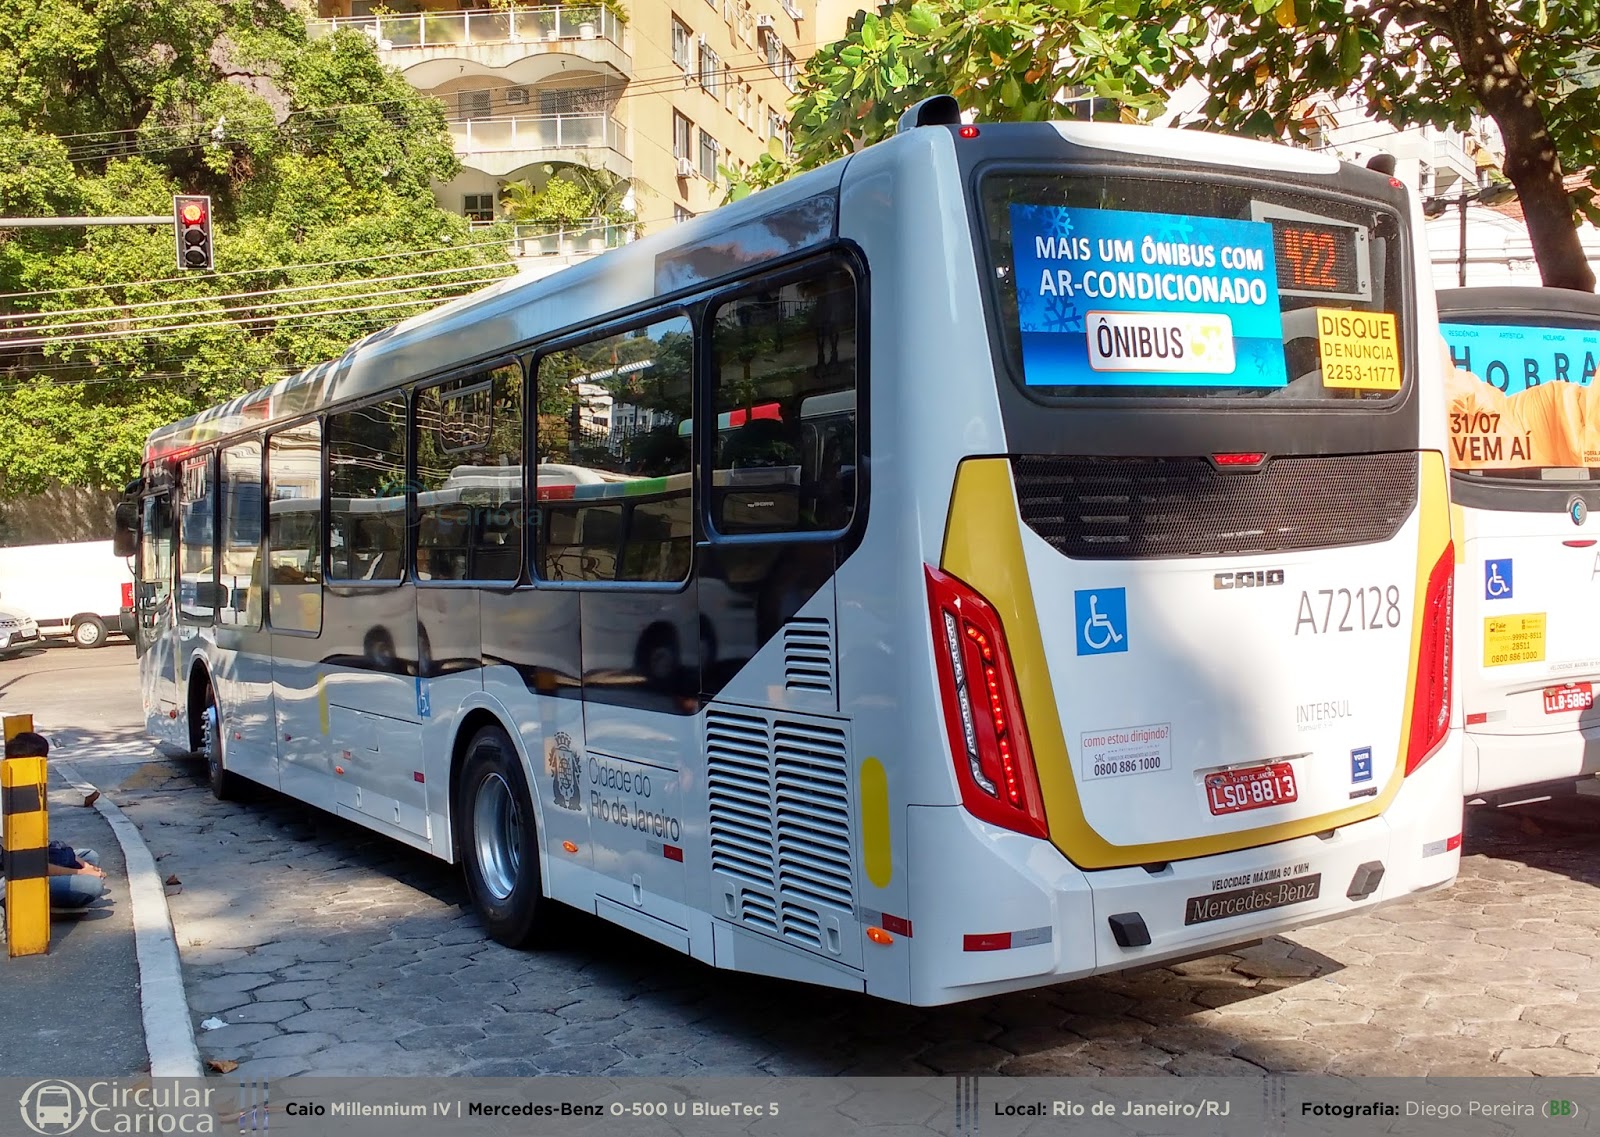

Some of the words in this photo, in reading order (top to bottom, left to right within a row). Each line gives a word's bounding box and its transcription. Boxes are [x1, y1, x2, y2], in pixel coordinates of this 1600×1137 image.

[1035, 236, 1090, 261] MAIS
[1099, 240, 1134, 264] UM
[1141, 236, 1215, 268] ÔNIBUS
[1221, 246, 1263, 271] COM
[1284, 229, 1337, 288] 422
[1039, 270, 1266, 305] AR-CONDICIONADO
[1099, 317, 1183, 359] ÔNIBUS
[1323, 316, 1391, 341] DISQUE
[1324, 340, 1393, 360] DENÚNCIA
[1326, 364, 1395, 382] 2253-1177
[1450, 413, 1500, 434] 31/07
[1452, 436, 1503, 461] VEM
[1510, 430, 1532, 461] AÍ
[1213, 569, 1284, 590] CAIO
[1295, 585, 1401, 635] A72128
[1297, 700, 1352, 723] INTERSUL
[1083, 736, 1106, 748] como
[1107, 733, 1129, 745] estou
[1130, 726, 1169, 743] dirigindo?
[1094, 753, 1105, 763] SAC
[1094, 762, 1118, 776] 0800
[1119, 760, 1137, 773] 886
[1138, 756, 1161, 770] 1000
[588, 757, 631, 793] Cidade
[634, 769, 651, 798] do
[590, 789, 609, 822] Rio
[611, 796, 628, 827] de
[630, 800, 680, 842] Janeiro
[1212, 874, 1251, 891] VELOCIDADE
[1252, 866, 1281, 883] MÁXIMA
[1283, 866, 1292, 877] 60
[1293, 862, 1310, 876] KM/H
[1192, 881, 1315, 921] Mercedes-Benz
